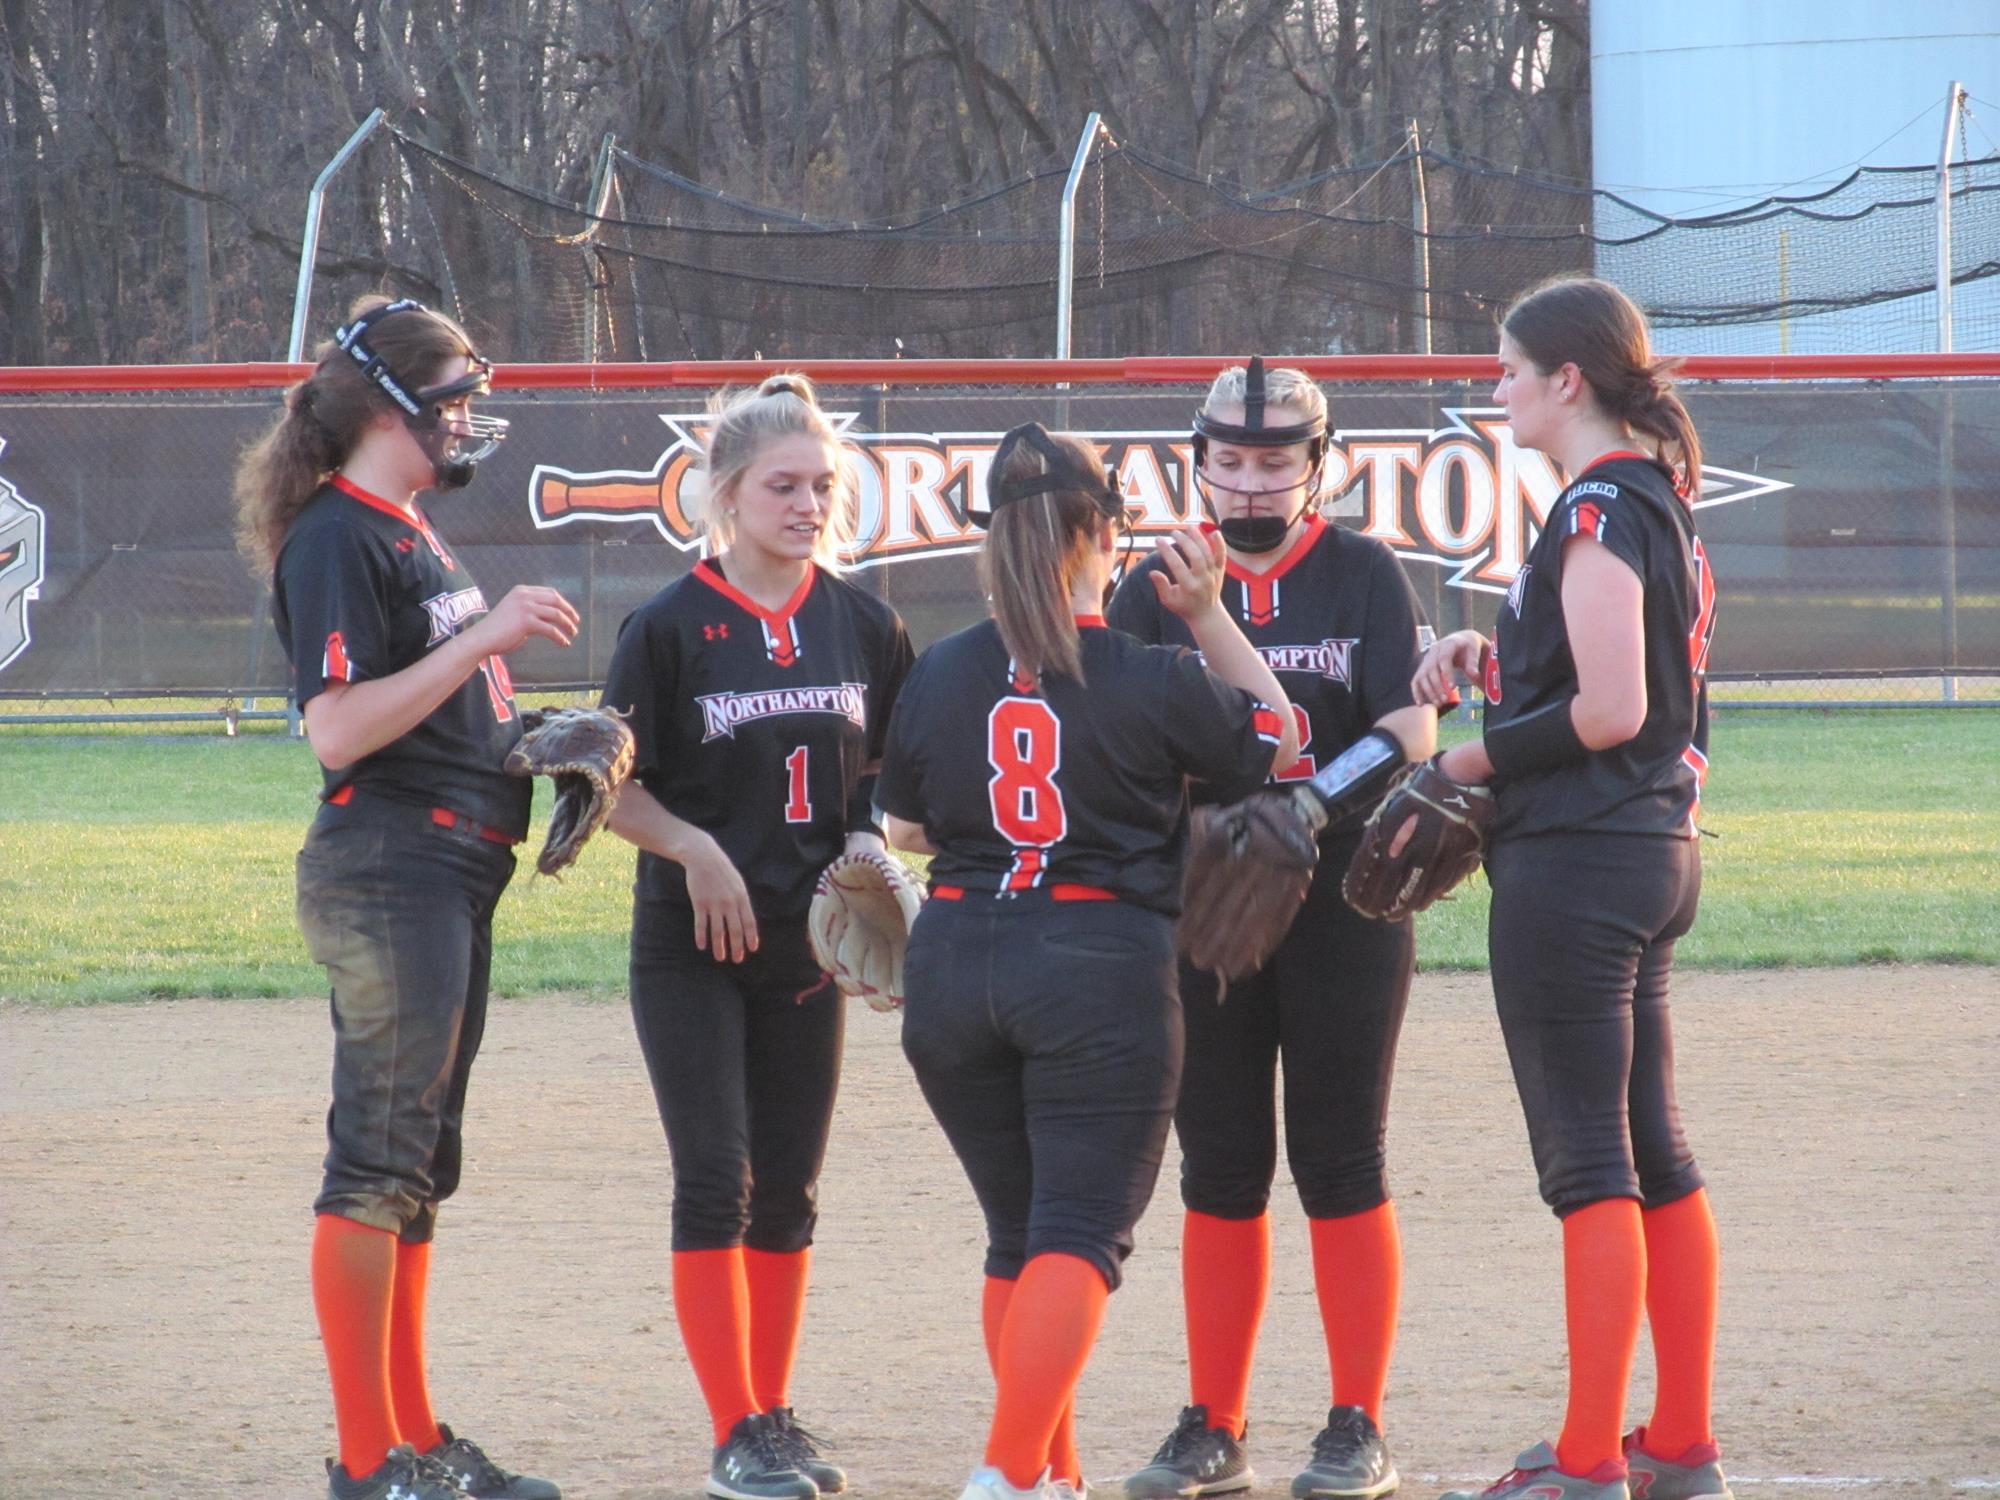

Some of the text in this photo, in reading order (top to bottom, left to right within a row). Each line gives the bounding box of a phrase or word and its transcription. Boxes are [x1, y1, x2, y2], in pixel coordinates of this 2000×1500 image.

[694, 682, 868, 744] NORTHAMPTON
[785, 745, 812, 824] 1
[988, 696, 1067, 848] 8
